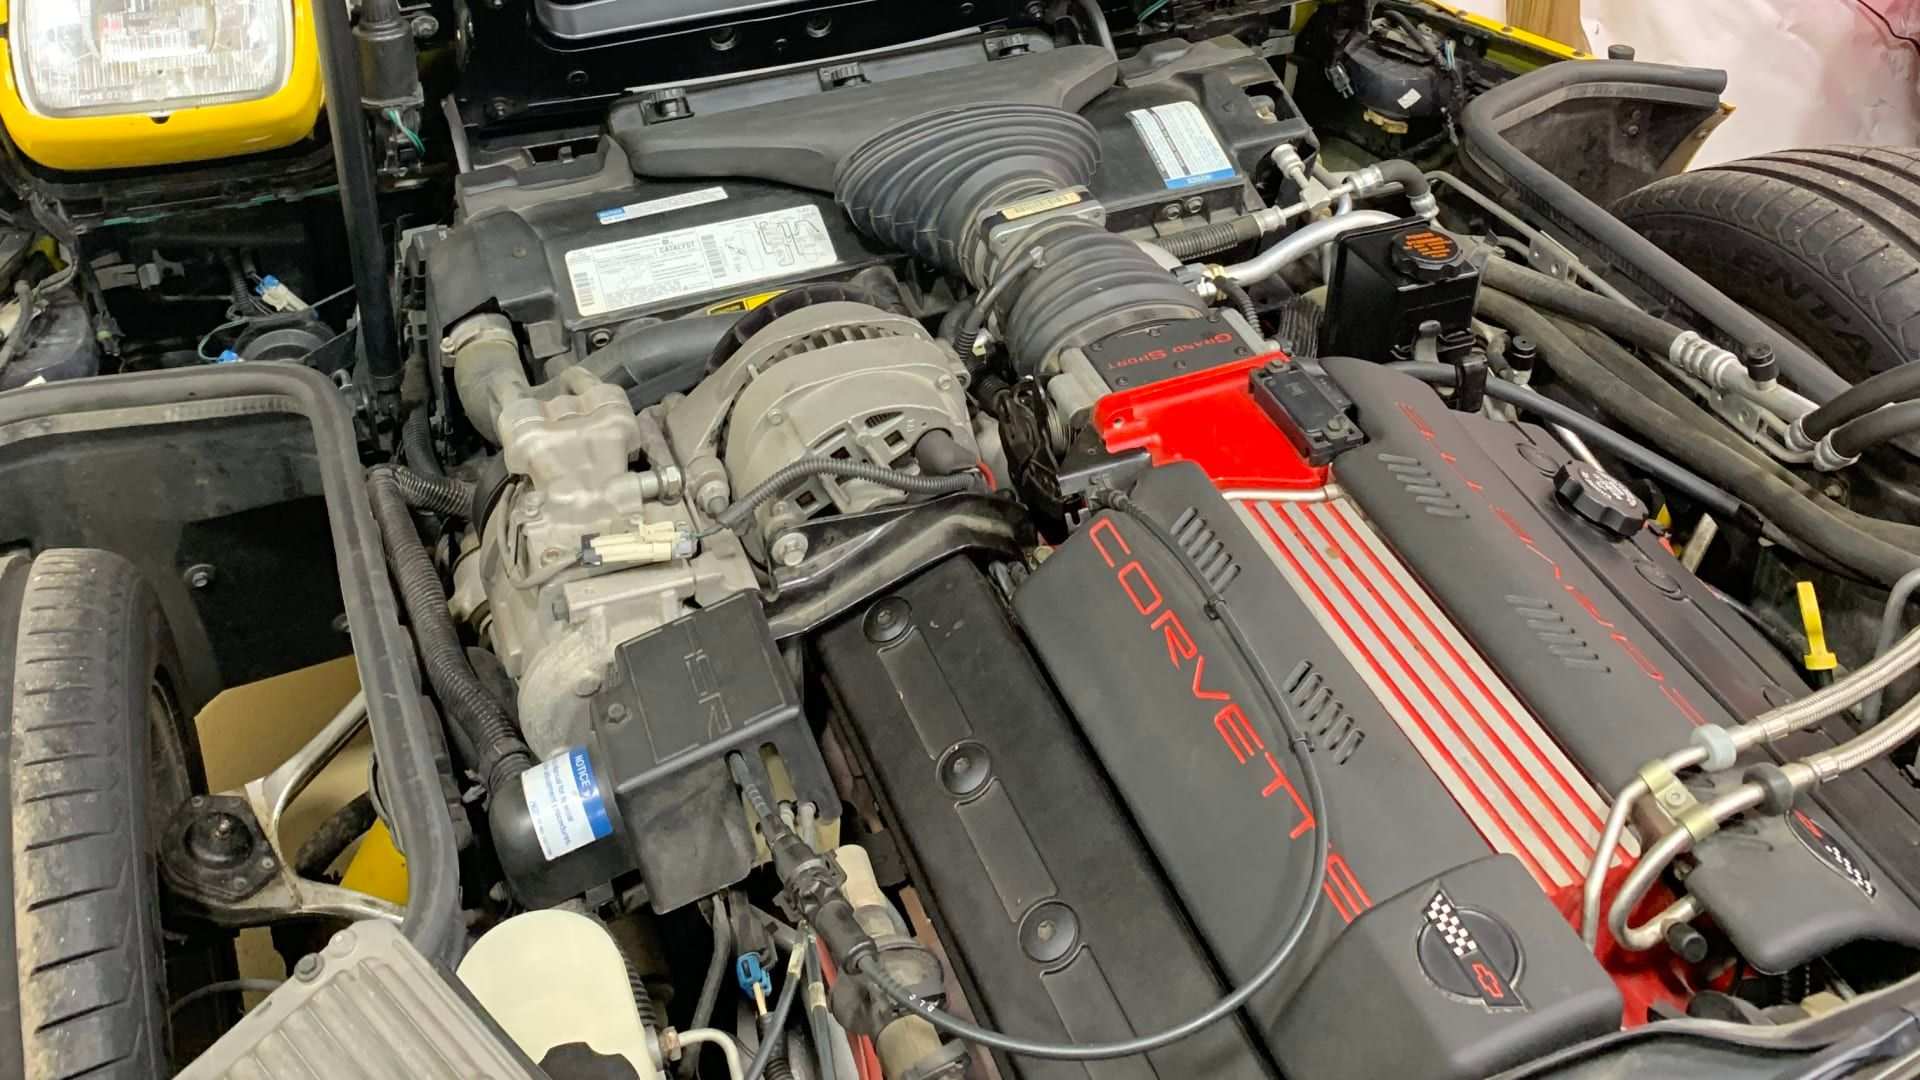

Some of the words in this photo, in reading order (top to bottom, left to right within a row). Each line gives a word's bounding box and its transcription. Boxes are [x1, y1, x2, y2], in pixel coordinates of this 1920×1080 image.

[1172, 332, 1233, 354] GRAND
[1106, 347, 1169, 370] SPORT
[1088, 515, 1374, 925] CORVETTE
[574, 754, 592, 788] NOTICE
